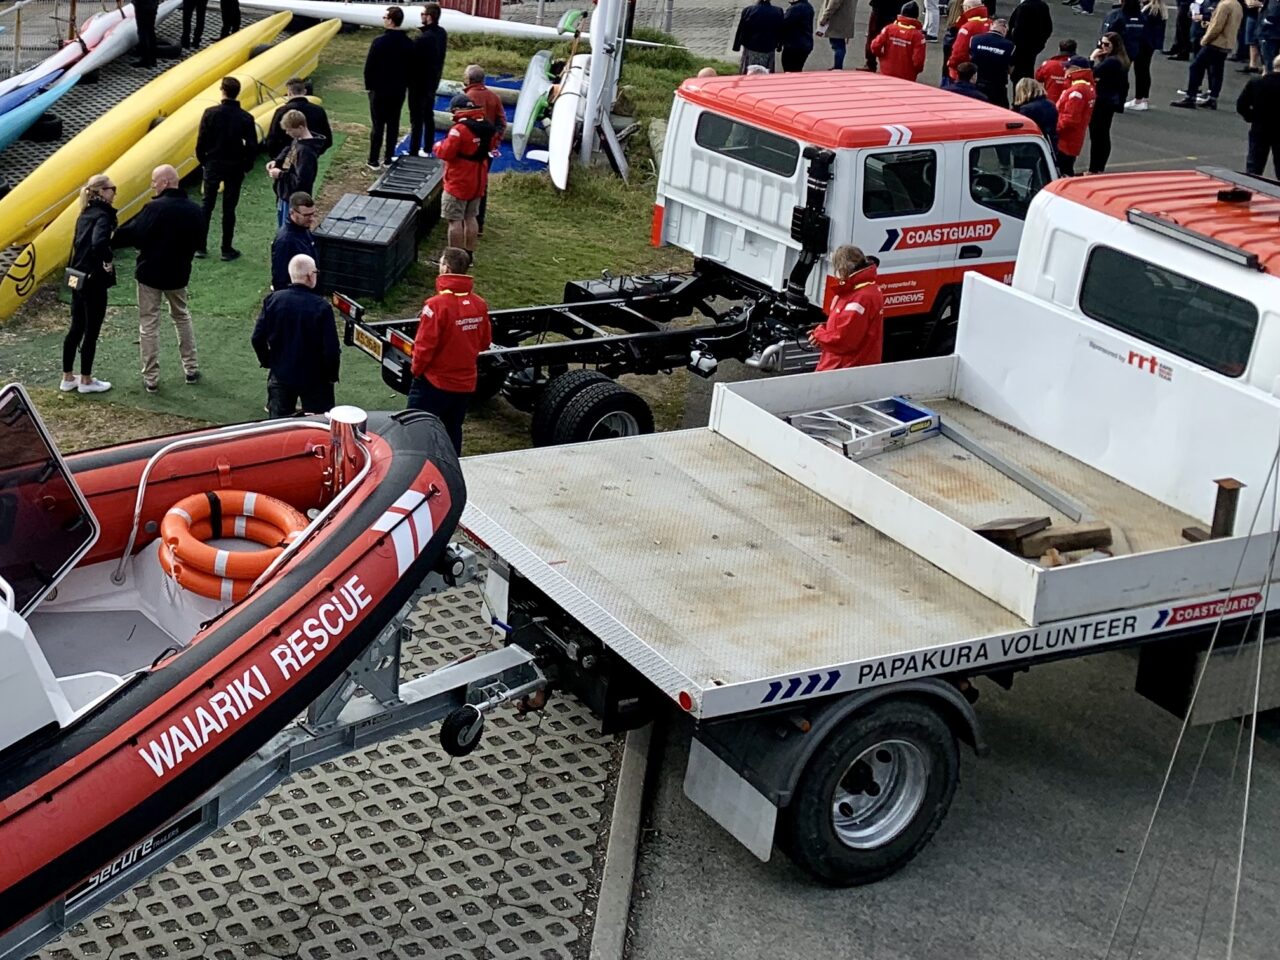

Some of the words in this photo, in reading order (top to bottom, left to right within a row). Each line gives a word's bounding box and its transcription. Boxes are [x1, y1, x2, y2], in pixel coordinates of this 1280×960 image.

[906, 223, 994, 245] COASTGUARD
[884, 292, 925, 306] ANDREWS
[1128, 350, 1158, 374] rrt
[1175, 596, 1257, 622] COASTGUARD
[858, 642, 989, 685] PAPAKURA
[1000, 615, 1138, 657] VOLUNTEER
[138, 664, 271, 778] WAIARIKI
[270, 574, 373, 680] RESCUE
